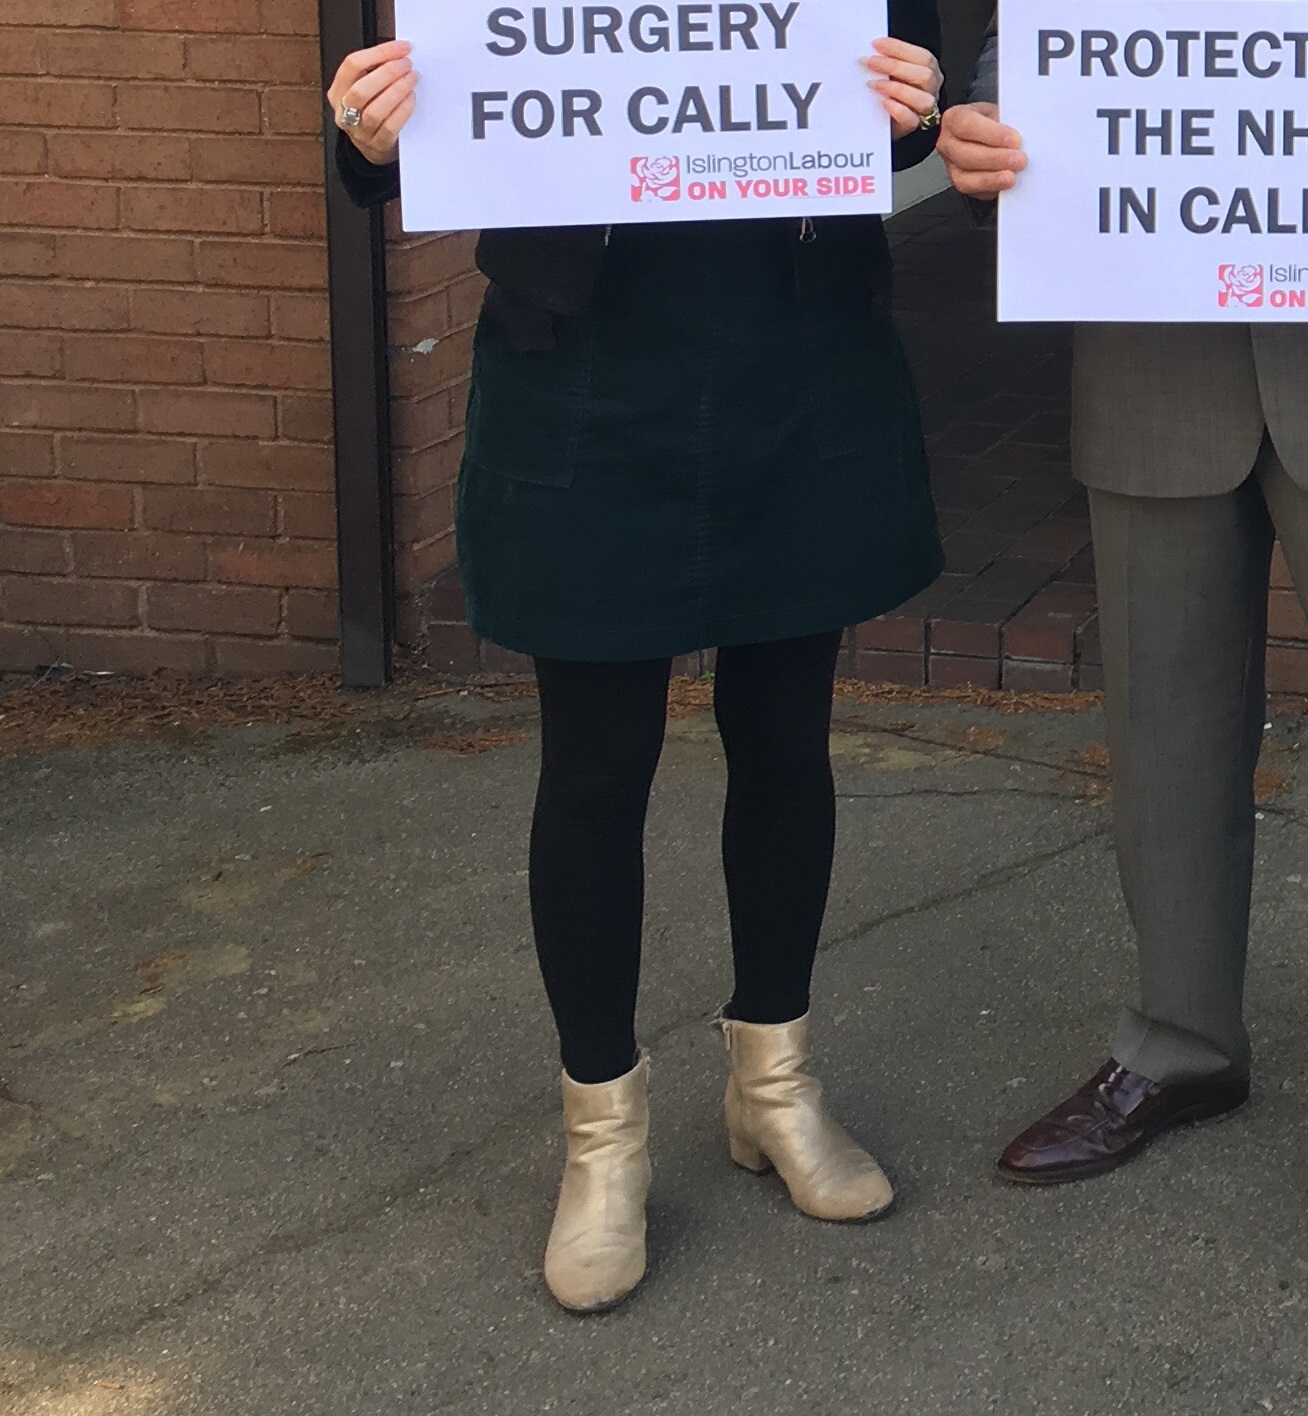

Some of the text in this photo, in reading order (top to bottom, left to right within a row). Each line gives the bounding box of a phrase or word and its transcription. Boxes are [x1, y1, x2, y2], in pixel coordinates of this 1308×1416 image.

[485, 1, 801, 57] SURGERY
[470, 82, 822, 141] FOR CALLY
[1095, 108, 1215, 156] THE
[686, 151, 875, 179] IslingtonLabour
[686, 175, 875, 201] ON YOUR SIDE
[1098, 186, 1157, 234] IN
[1268, 290, 1307, 309] ON
